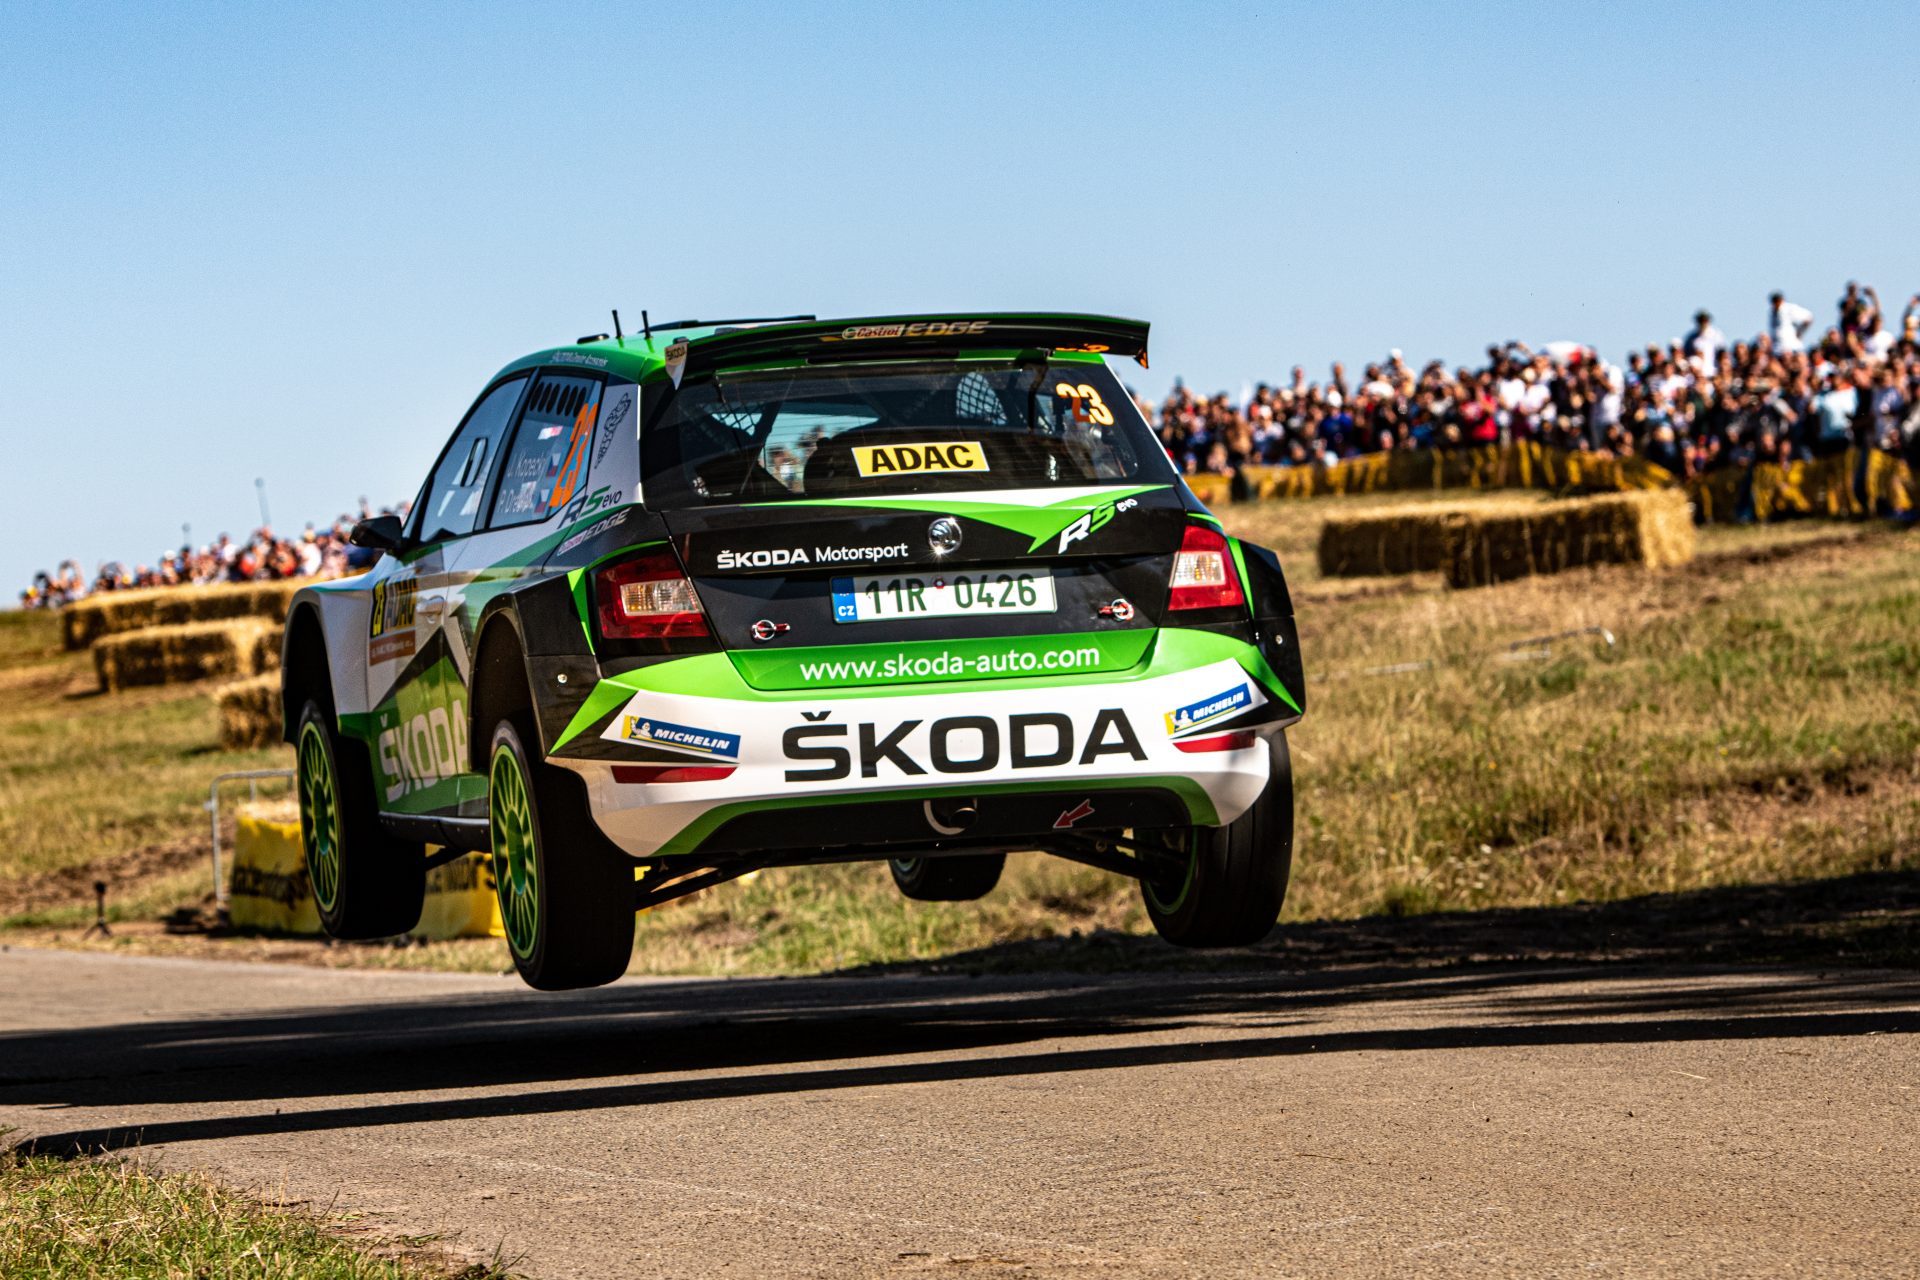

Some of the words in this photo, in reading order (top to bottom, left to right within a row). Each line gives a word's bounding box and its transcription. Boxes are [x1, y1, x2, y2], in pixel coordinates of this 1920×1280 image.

[856, 326, 901, 338] Castrol
[902, 321, 991, 337] EDGE
[1056, 383, 1114, 426] 23
[872, 445, 974, 472] ADAC
[583, 507, 632, 542] EDGE
[717, 549, 810, 569] ŠKODA
[815, 543, 909, 562] Motorsport
[865, 578, 927, 614] 11R
[953, 574, 1037, 609] 0426
[838, 605, 855, 616] CZ
[800, 648, 1099, 680] www.skoda-auto.com
[1193, 691, 1244, 719] MICHELIN
[379, 699, 468, 803] ŠKODA
[654, 728, 730, 750] MICHELIN
[782, 708, 1149, 782] ŠKODA
